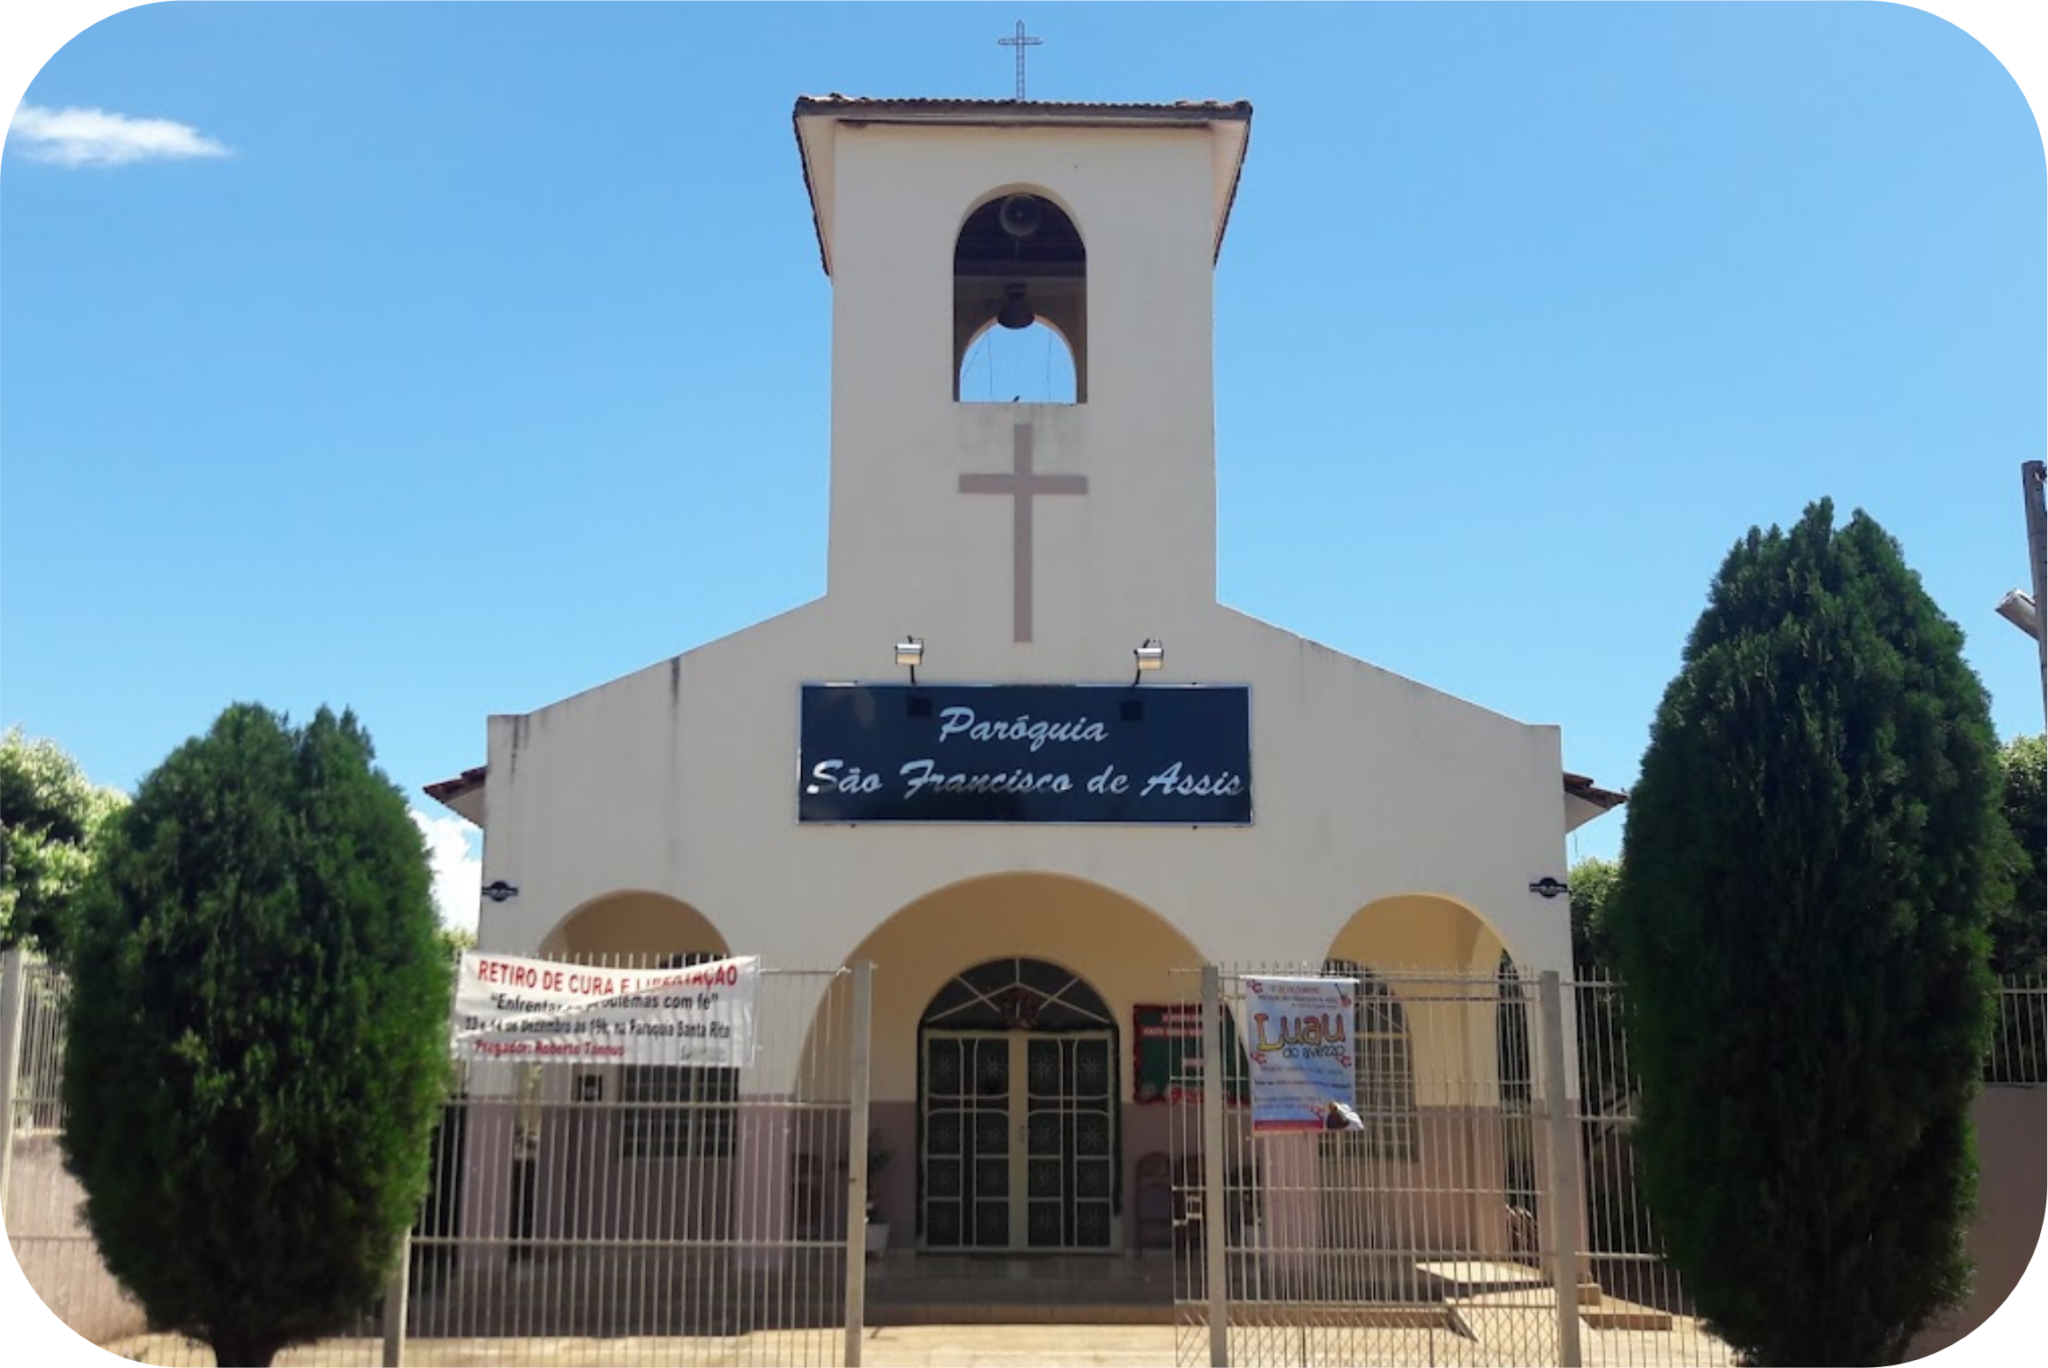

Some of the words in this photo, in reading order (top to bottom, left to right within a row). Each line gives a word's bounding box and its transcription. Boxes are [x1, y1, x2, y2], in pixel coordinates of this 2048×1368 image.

[939, 706, 1108, 751] Paróquia
[806, 759, 883, 794] São
[900, 759, 1073, 799] Francisco
[1086, 765, 1129, 794] de
[1140, 761, 1245, 796] Assis
[478, 960, 536, 988] RETIRO
[542, 970, 564, 991] DE
[568, 974, 614, 996] CURA
[620, 978, 631, 994] E
[663, 994, 692, 1009] com
[1254, 1013, 1346, 1051] Luau
